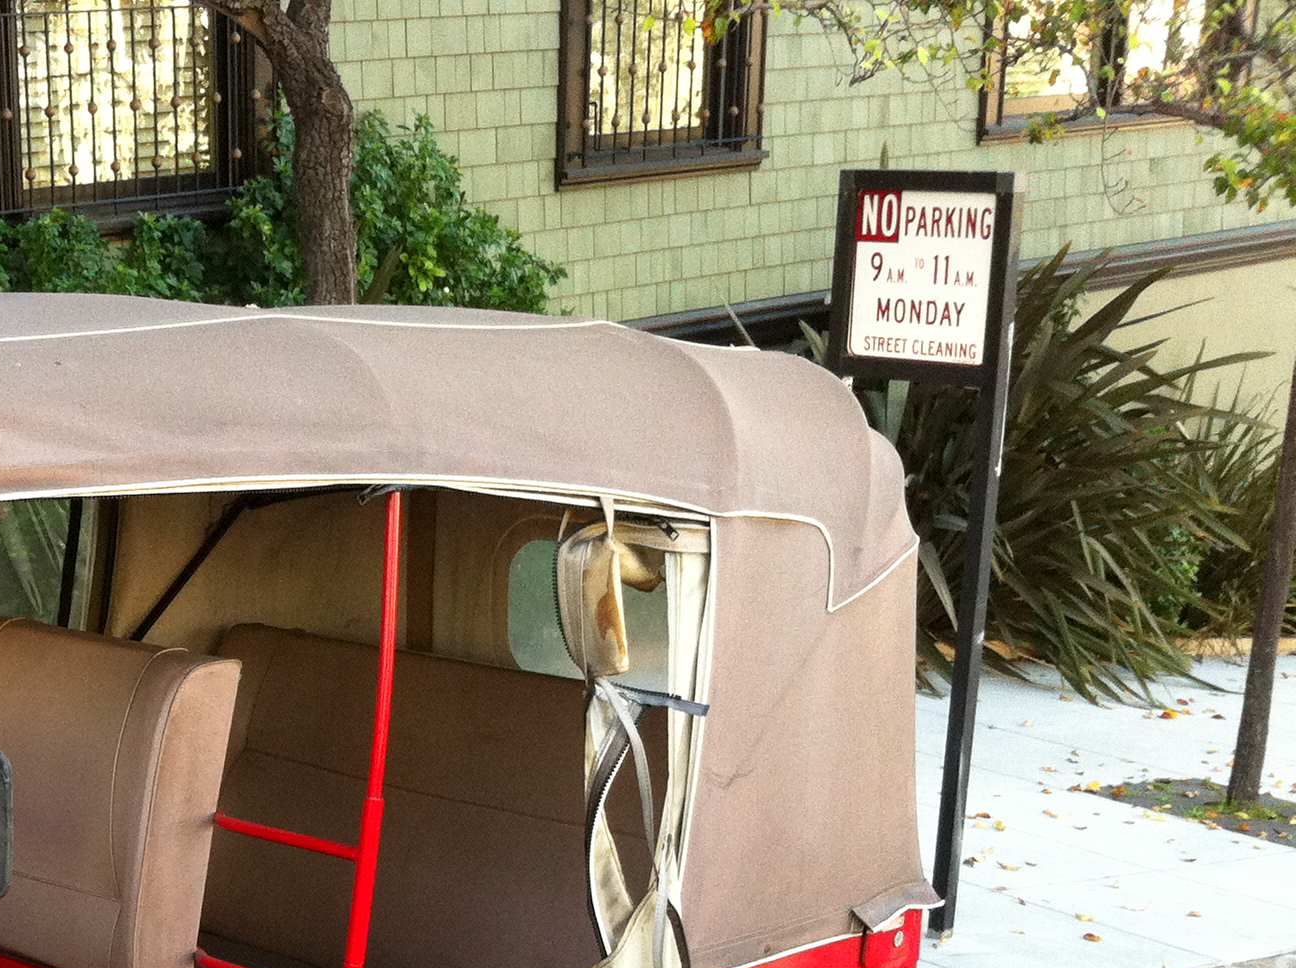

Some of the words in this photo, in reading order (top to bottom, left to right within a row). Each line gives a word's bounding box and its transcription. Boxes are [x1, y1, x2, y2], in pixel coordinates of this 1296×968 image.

[861, 193, 899, 238] NO
[904, 206, 993, 240] PARKING
[870, 252, 884, 282] 9
[915, 258, 924, 269] TO
[933, 254, 950, 285] 11
[876, 297, 966, 327] MONDAY
[863, 336, 908, 354] STREET
[912, 339, 977, 360] CLEANING
